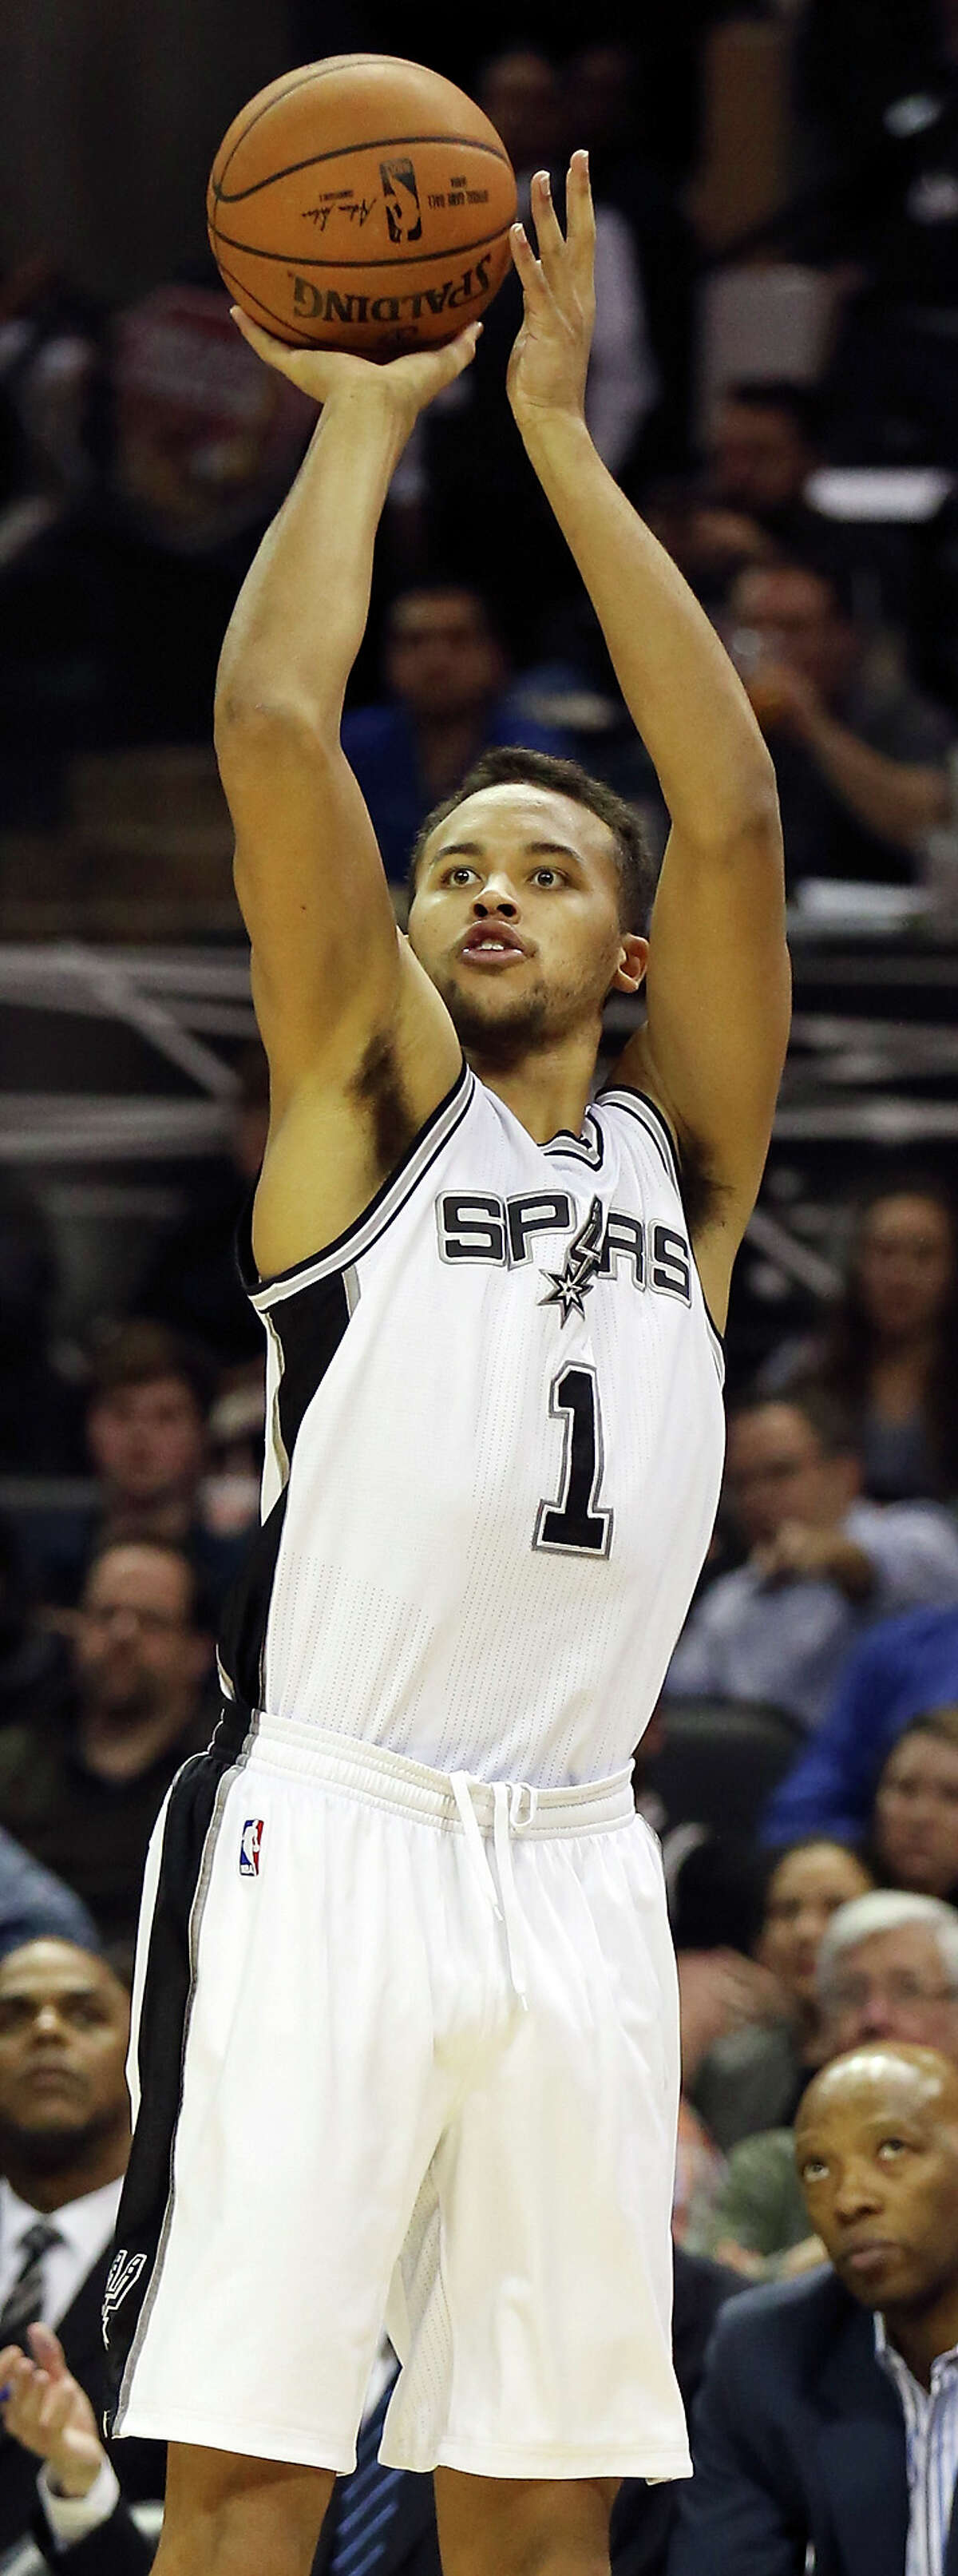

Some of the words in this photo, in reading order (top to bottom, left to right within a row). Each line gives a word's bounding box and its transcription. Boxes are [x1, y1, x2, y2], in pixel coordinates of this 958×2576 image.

[293, 253, 492, 323] SPALDING
[436, 1189, 692, 1311] SPURS
[532, 1360, 614, 1559] 1
